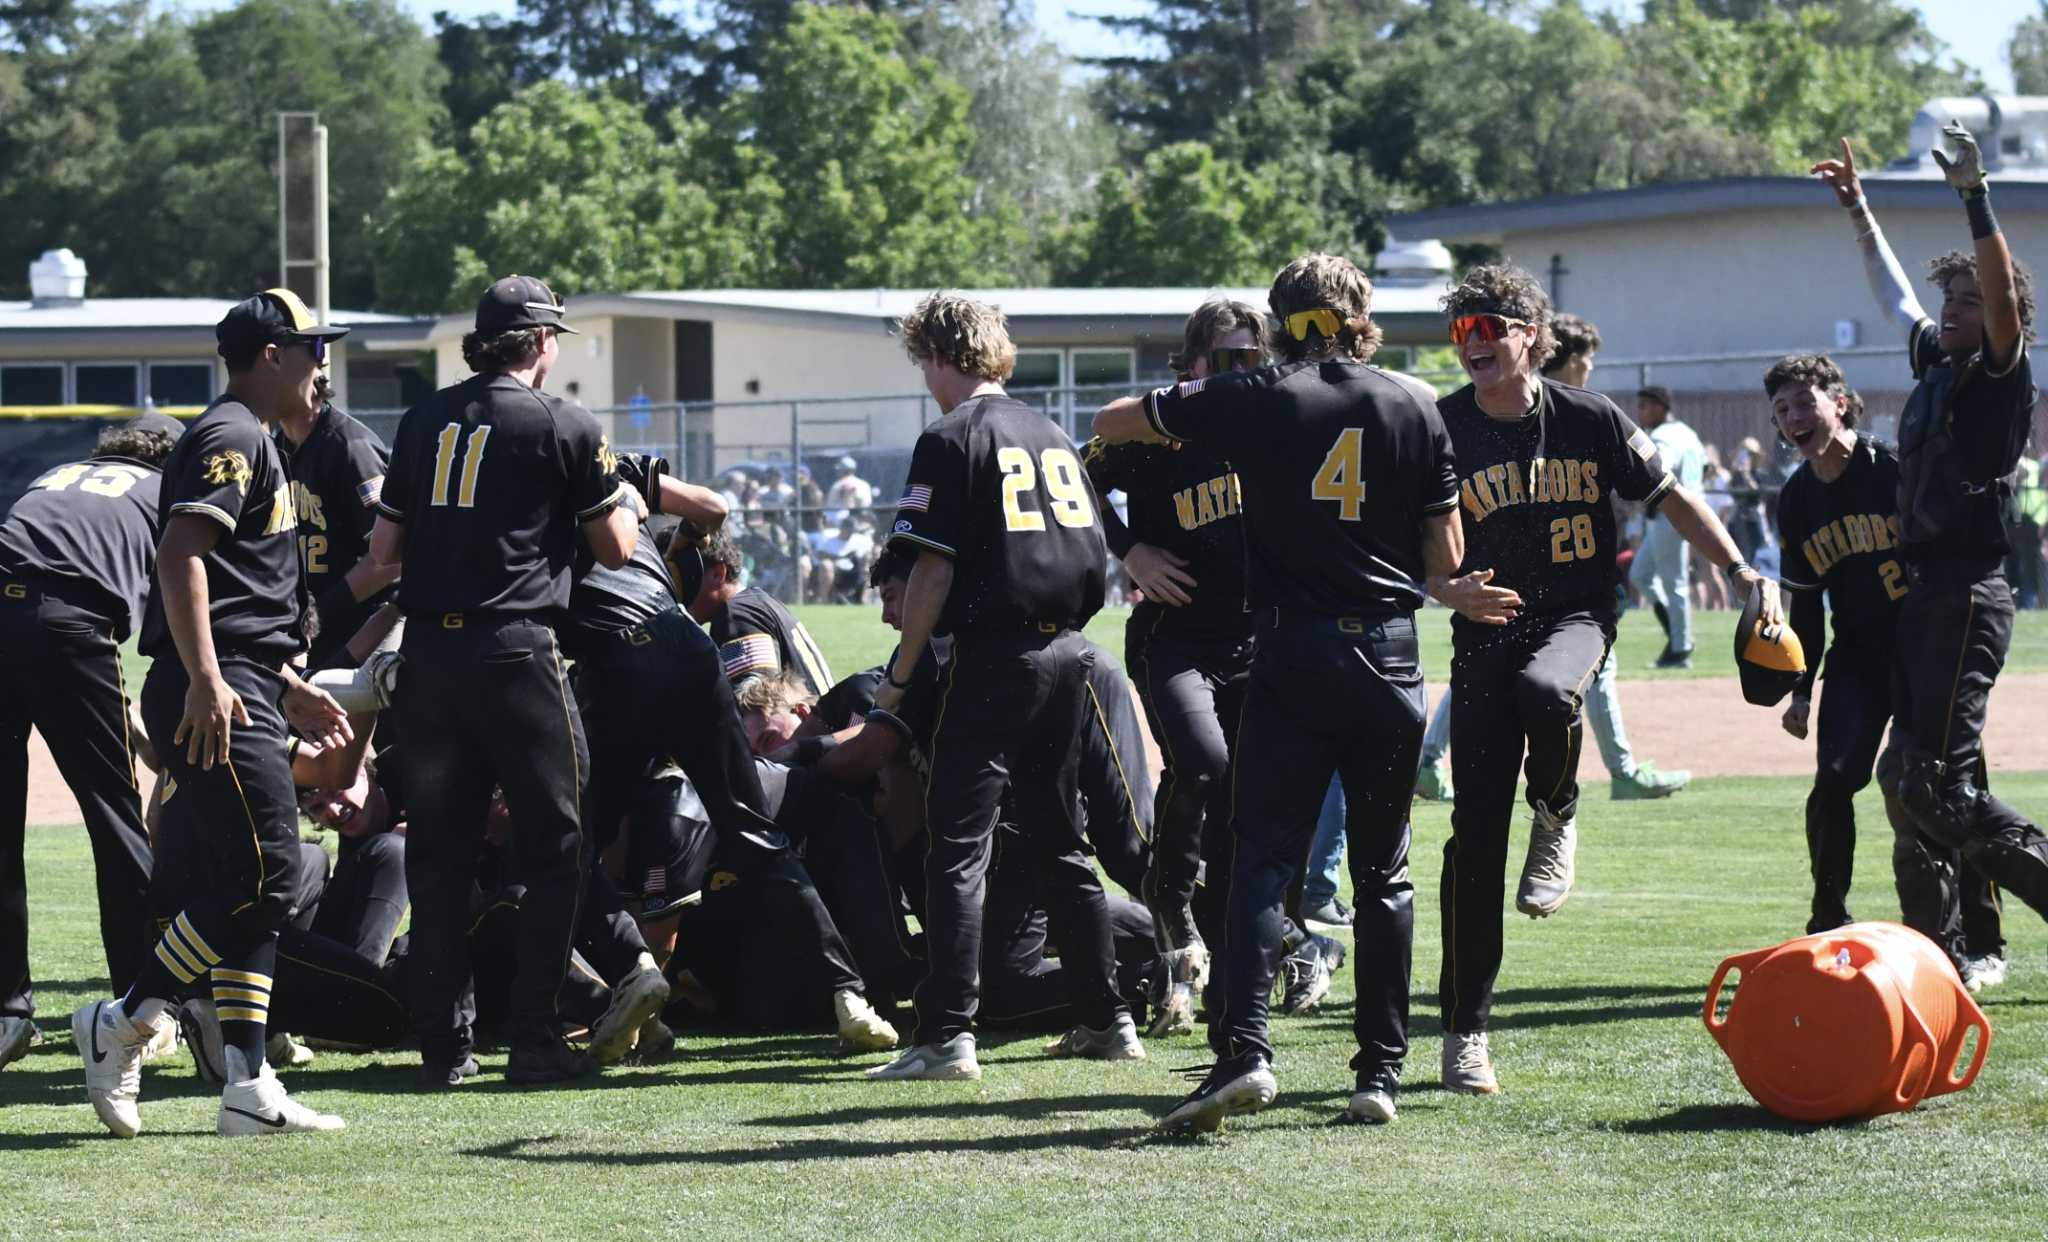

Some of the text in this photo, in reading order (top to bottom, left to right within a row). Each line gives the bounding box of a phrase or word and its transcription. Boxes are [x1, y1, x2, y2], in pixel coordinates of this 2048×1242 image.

[431, 422, 492, 508] 11
[997, 446, 1094, 532] 29
[1311, 427, 1366, 521] 4
[1550, 514, 1596, 563] 28
[442, 612, 464, 629] G
[1337, 617, 1363, 633] G
